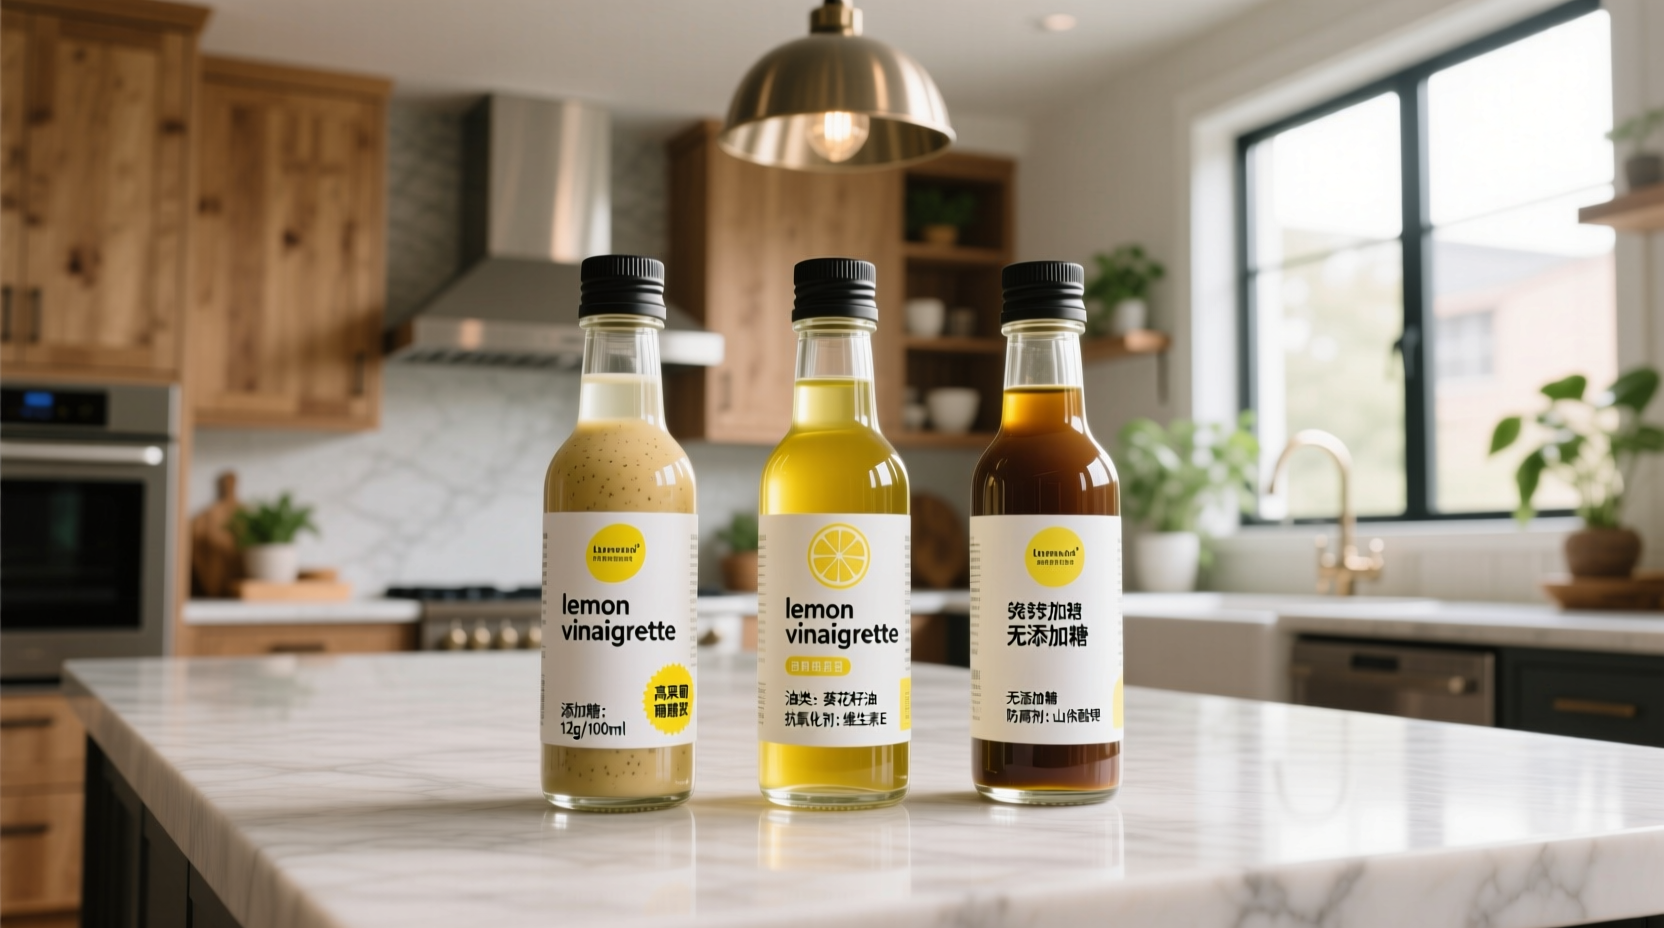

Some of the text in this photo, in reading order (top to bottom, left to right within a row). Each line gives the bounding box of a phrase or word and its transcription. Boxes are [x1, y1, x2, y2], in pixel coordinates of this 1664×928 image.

[562, 592, 630, 616] lemon
[786, 596, 854, 619] lemon
[561, 618, 676, 647] vinaigrette
[785, 621, 899, 650] vinaigrette
[1007, 623, 1089, 647] 无添加糖
[560, 720, 626, 741] 12g/100ml
